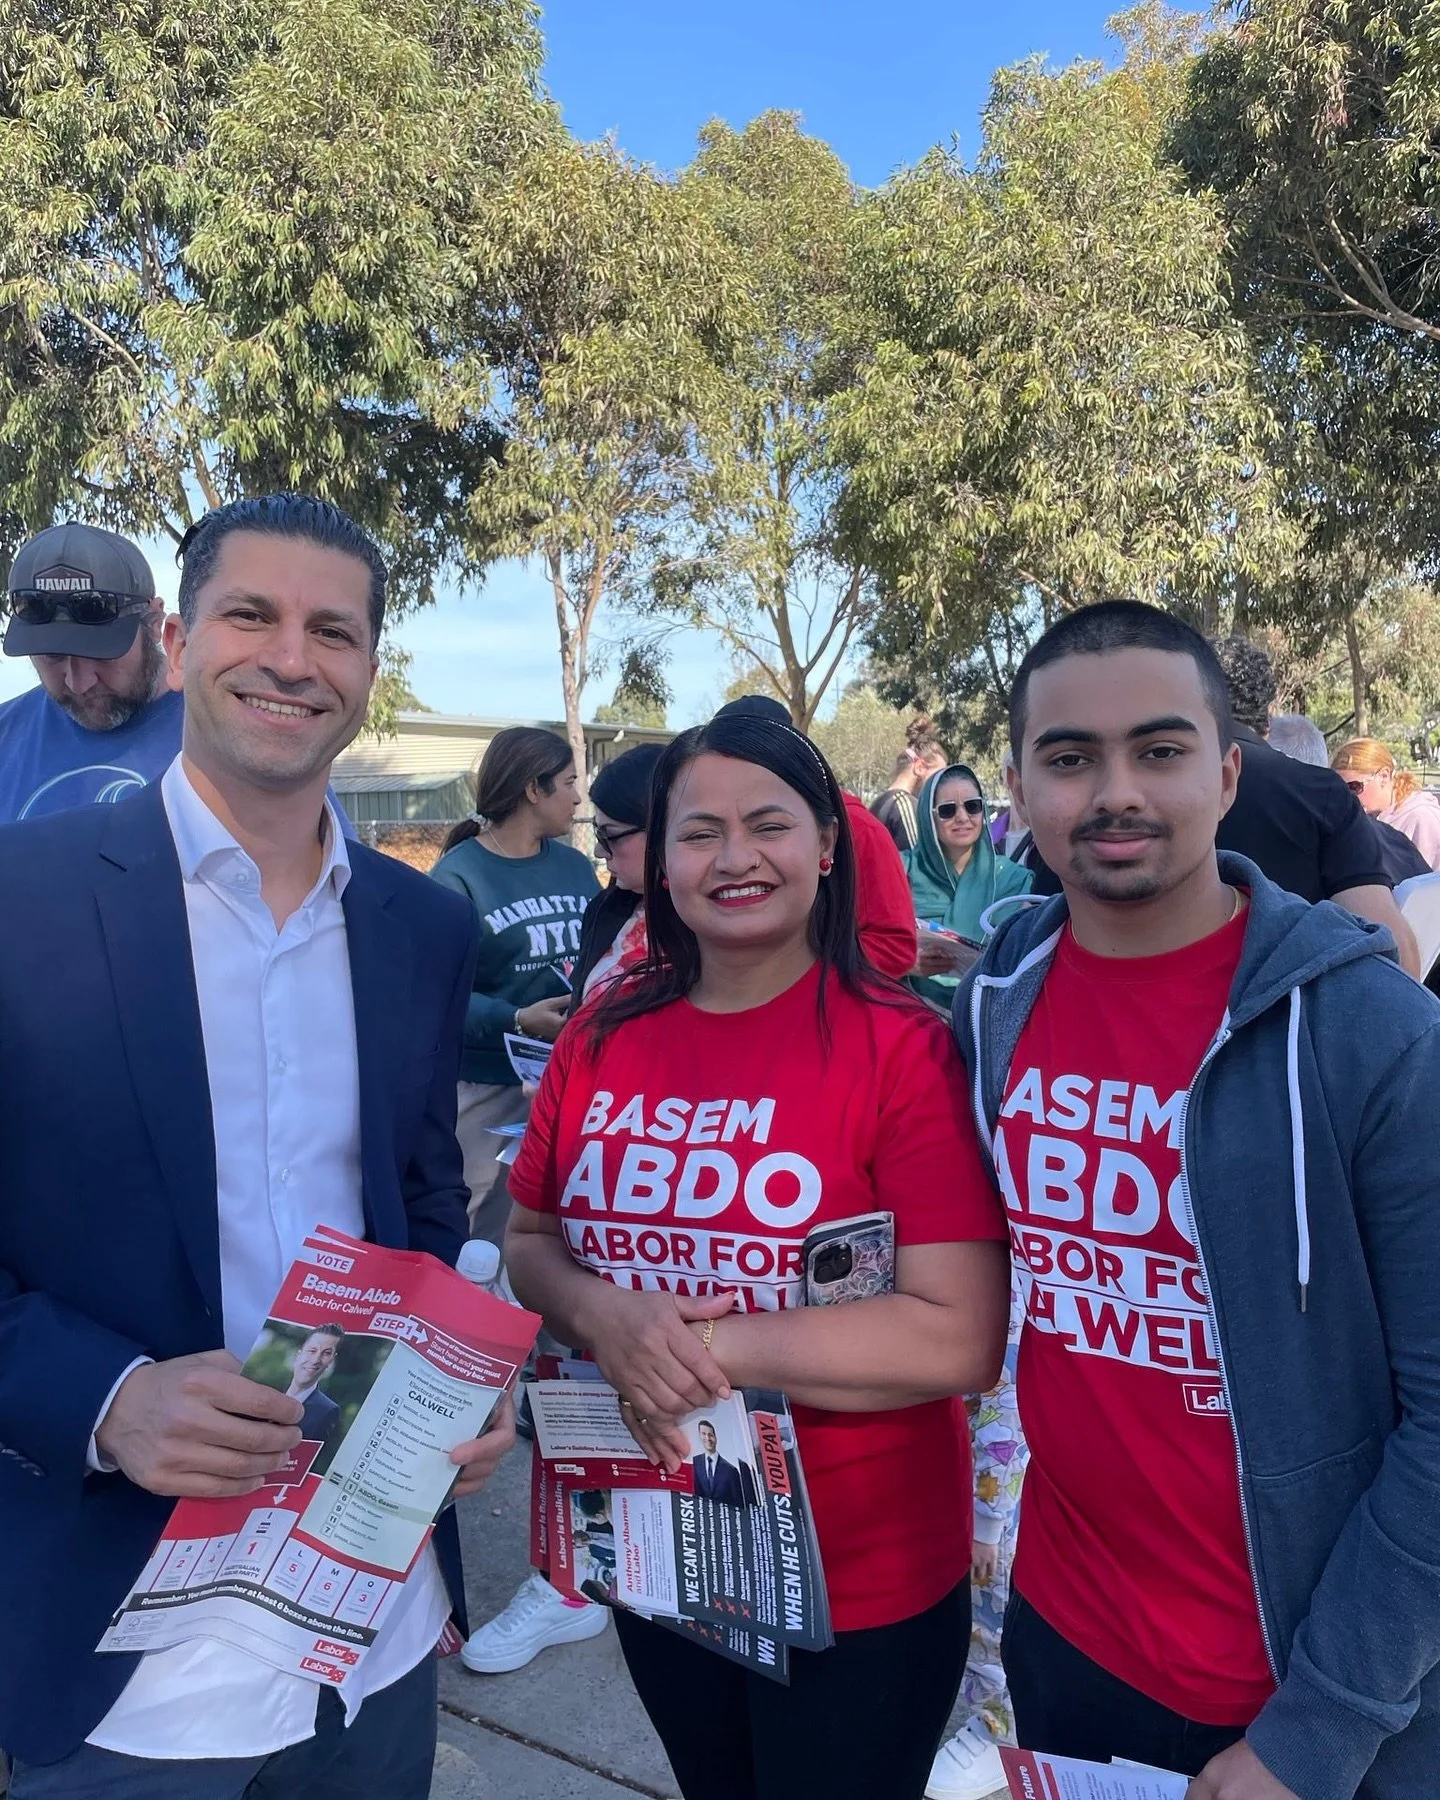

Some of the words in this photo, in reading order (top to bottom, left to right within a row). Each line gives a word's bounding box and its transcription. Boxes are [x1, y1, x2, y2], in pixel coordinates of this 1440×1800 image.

[36, 577, 91, 591] HAWAII
[484, 895, 590, 935] MANHATTA
[526, 919, 582, 957] NYC
[580, 1090, 776, 1145] BASEM
[999, 1067, 1189, 1149] ASEM
[560, 1140, 823, 1228] ABDO
[315, 1253, 350, 1271] VOTE
[563, 1223, 696, 1270] LABOR
[710, 1237, 804, 1279] FOR
[1011, 1226, 1126, 1294] ABOR
[1145, 1256, 1210, 1306] FO
[295, 1291, 328, 1308] Labor
[326, 1297, 343, 1311] for
[342, 1302, 373, 1316] Calwell
[302, 1272, 362, 1301] Basem
[362, 1286, 402, 1306] Abdo
[373, 1317, 404, 1331] STEP
[406, 1325, 413, 1335] 1
[1027, 1280, 1220, 1372] ALWEL
[427, 1349, 453, 1367] number
[451, 1363, 473, 1377] every
[470, 1364, 484, 1373] you
[483, 1368, 501, 1379] must
[386, 1407, 396, 1416] 10
[408, 1390, 456, 1420] CALWELL
[370, 1440, 378, 1449] 12
[760, 1418, 780, 1455] PAY.
[352, 1471, 361, 1480] 13
[767, 1457, 787, 1489] YOU
[329, 1515, 337, 1524] 11
[557, 1525, 565, 1535] is
[621, 1497, 631, 1547] Albanese
[680, 1498, 696, 1533] RISK
[176, 1560, 185, 1568] 2
[246, 1542, 257, 1555] 1
[558, 1537, 568, 1569] Labor
[633, 1544, 641, 1579] Labor
[682, 1534, 699, 1579] CAN'T
[781, 1544, 800, 1572] HE
[289, 1563, 297, 1573] 5
[324, 1582, 332, 1591] 6
[359, 1594, 367, 1602] 3
[331, 1568, 340, 1576] M
[625, 1548, 634, 1593] Anthony
[684, 1578, 700, 1603] WE
[783, 1573, 803, 1630] WHEN
[217, 1584, 250, 1595] number
[247, 1589, 257, 1598] at
[256, 1591, 278, 1607] least
[277, 1602, 284, 1610] 6
[283, 1604, 307, 1622] boxes
[306, 1616, 333, 1631] above
[332, 1625, 347, 1635] the
[346, 1629, 364, 1640] line.
[317, 1641, 346, 1657] Labor
[757, 1635, 776, 1666] WH
[303, 1658, 332, 1674] Labor
[1019, 1764, 1036, 1800] Future
